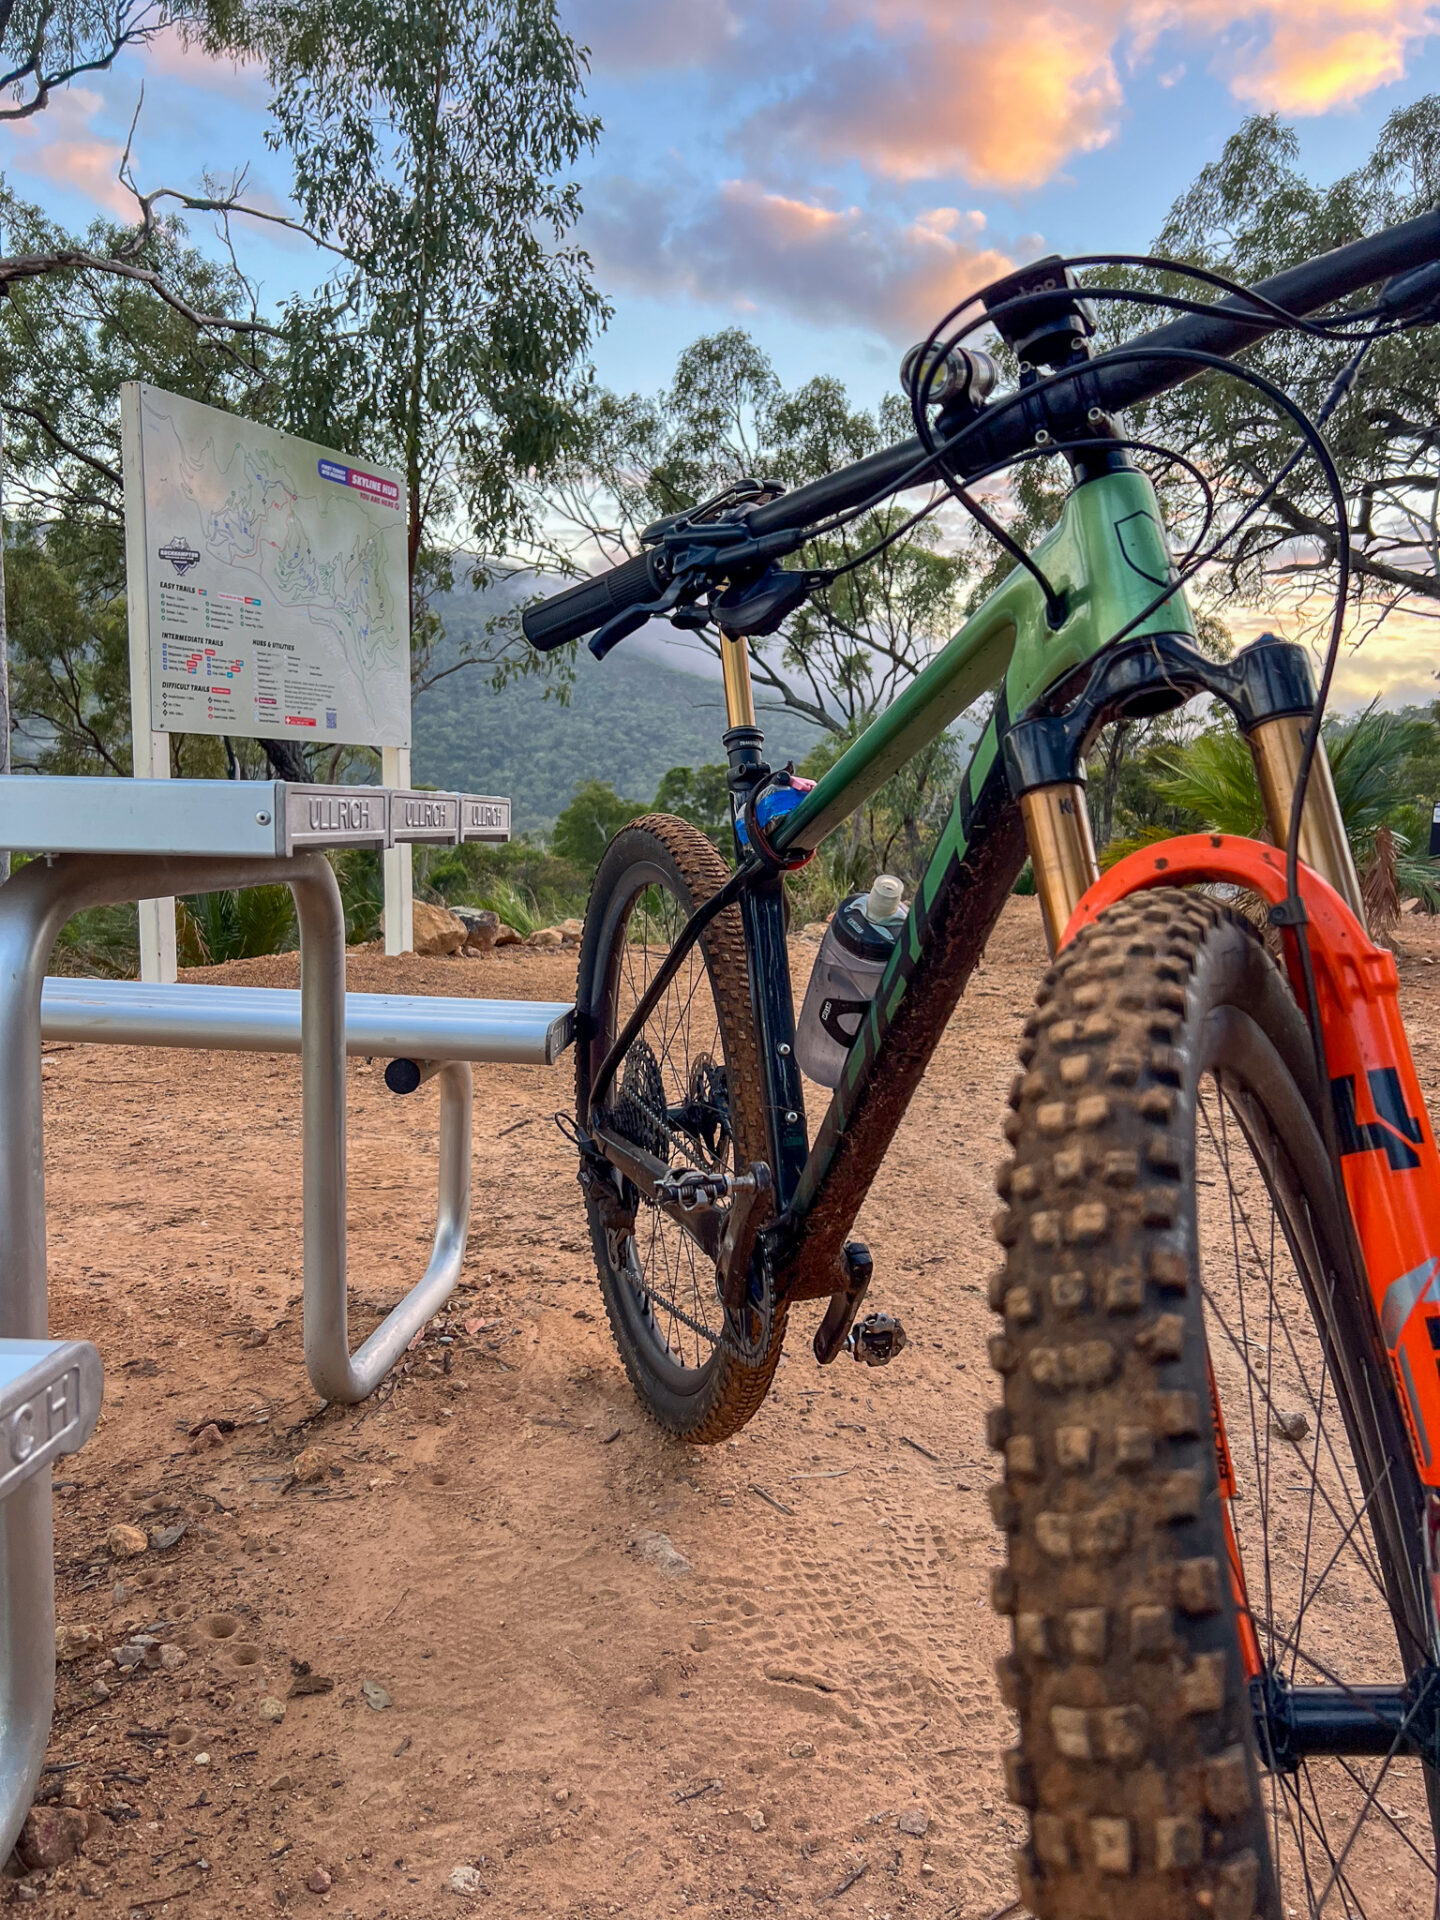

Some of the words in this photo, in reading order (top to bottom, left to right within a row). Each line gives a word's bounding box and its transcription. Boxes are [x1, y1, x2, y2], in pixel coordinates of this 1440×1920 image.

[352, 475, 382, 492] SKYLINE
[382, 484, 397, 497] HUB
[160, 581, 175, 591] EASY
[176, 584, 196, 594] TRAILS
[162, 631, 204, 645] INTERMEDIATE
[204, 637, 224, 647] TRAILS
[162, 681, 190, 691] DIFFICULT
[190, 684, 210, 693] TRAILS
[308, 798, 369, 830] ULLRICH
[405, 800, 447, 828] ULLRICH
[471, 802, 502, 827] ULLRICH
